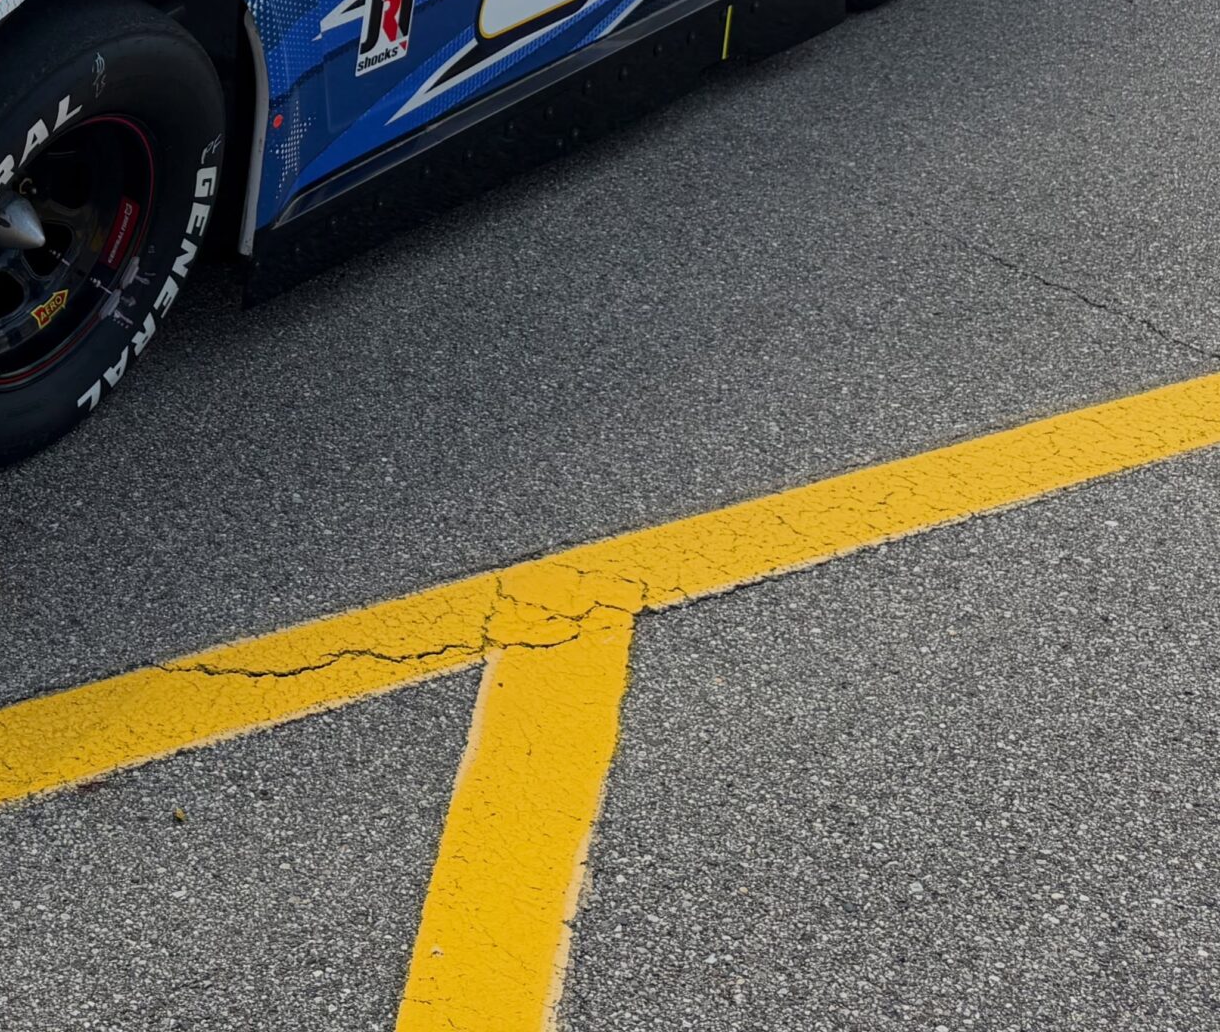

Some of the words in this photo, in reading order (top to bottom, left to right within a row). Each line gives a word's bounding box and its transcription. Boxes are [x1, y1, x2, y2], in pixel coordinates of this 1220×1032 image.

[357, 46, 399, 72] shocks
[77, 166, 218, 412] GENERAL
[38, 294, 64, 323] AERO
